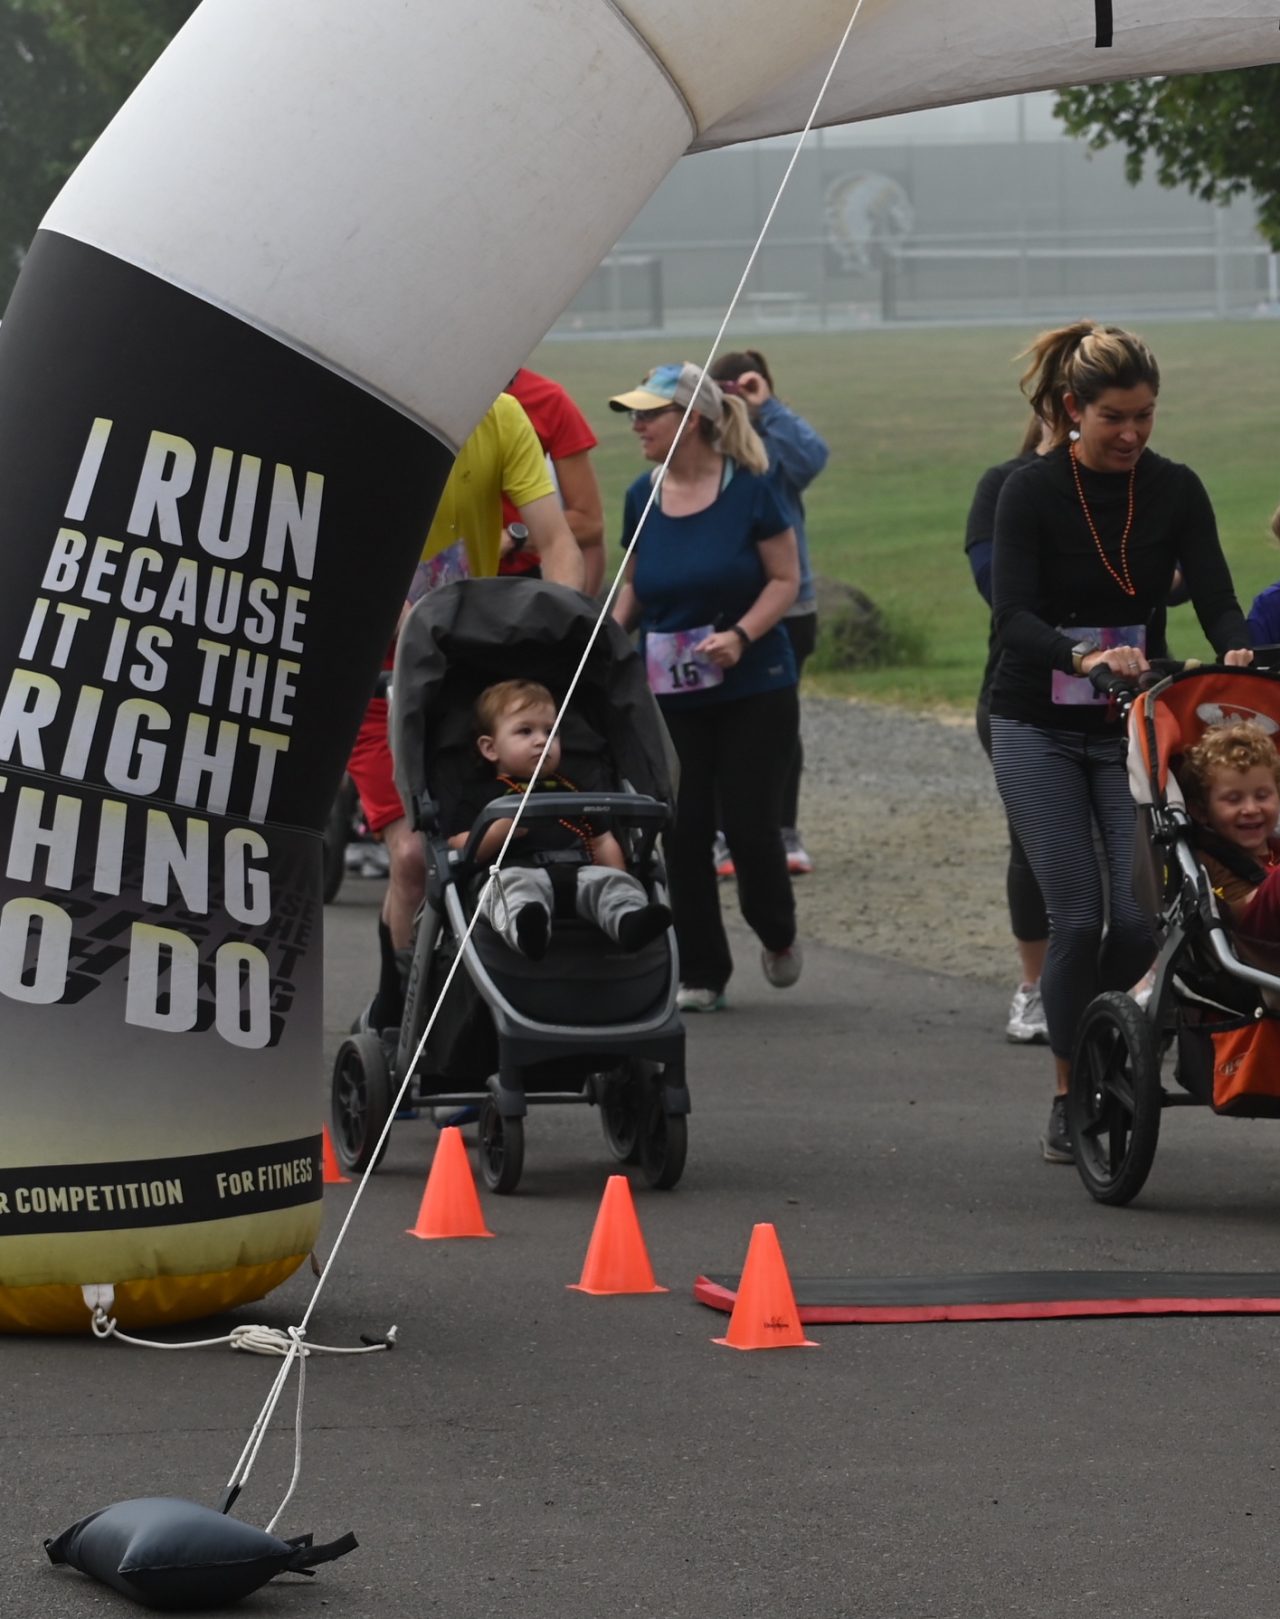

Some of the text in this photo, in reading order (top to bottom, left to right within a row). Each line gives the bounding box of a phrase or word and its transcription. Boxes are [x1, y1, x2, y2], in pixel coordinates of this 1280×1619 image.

[64, 417, 325, 581] I RUN
[40, 527, 310, 654] BECAUSE
[18, 597, 301, 726] IT IS THE
[669, 662, 699, 688] 15
[0, 668, 290, 824] RIGHT
[0, 775, 271, 926] HING
[0, 897, 271, 1050] O DO
[15, 1178, 184, 1214] COMPETITION
[258, 1156, 313, 1192] FITNESS
